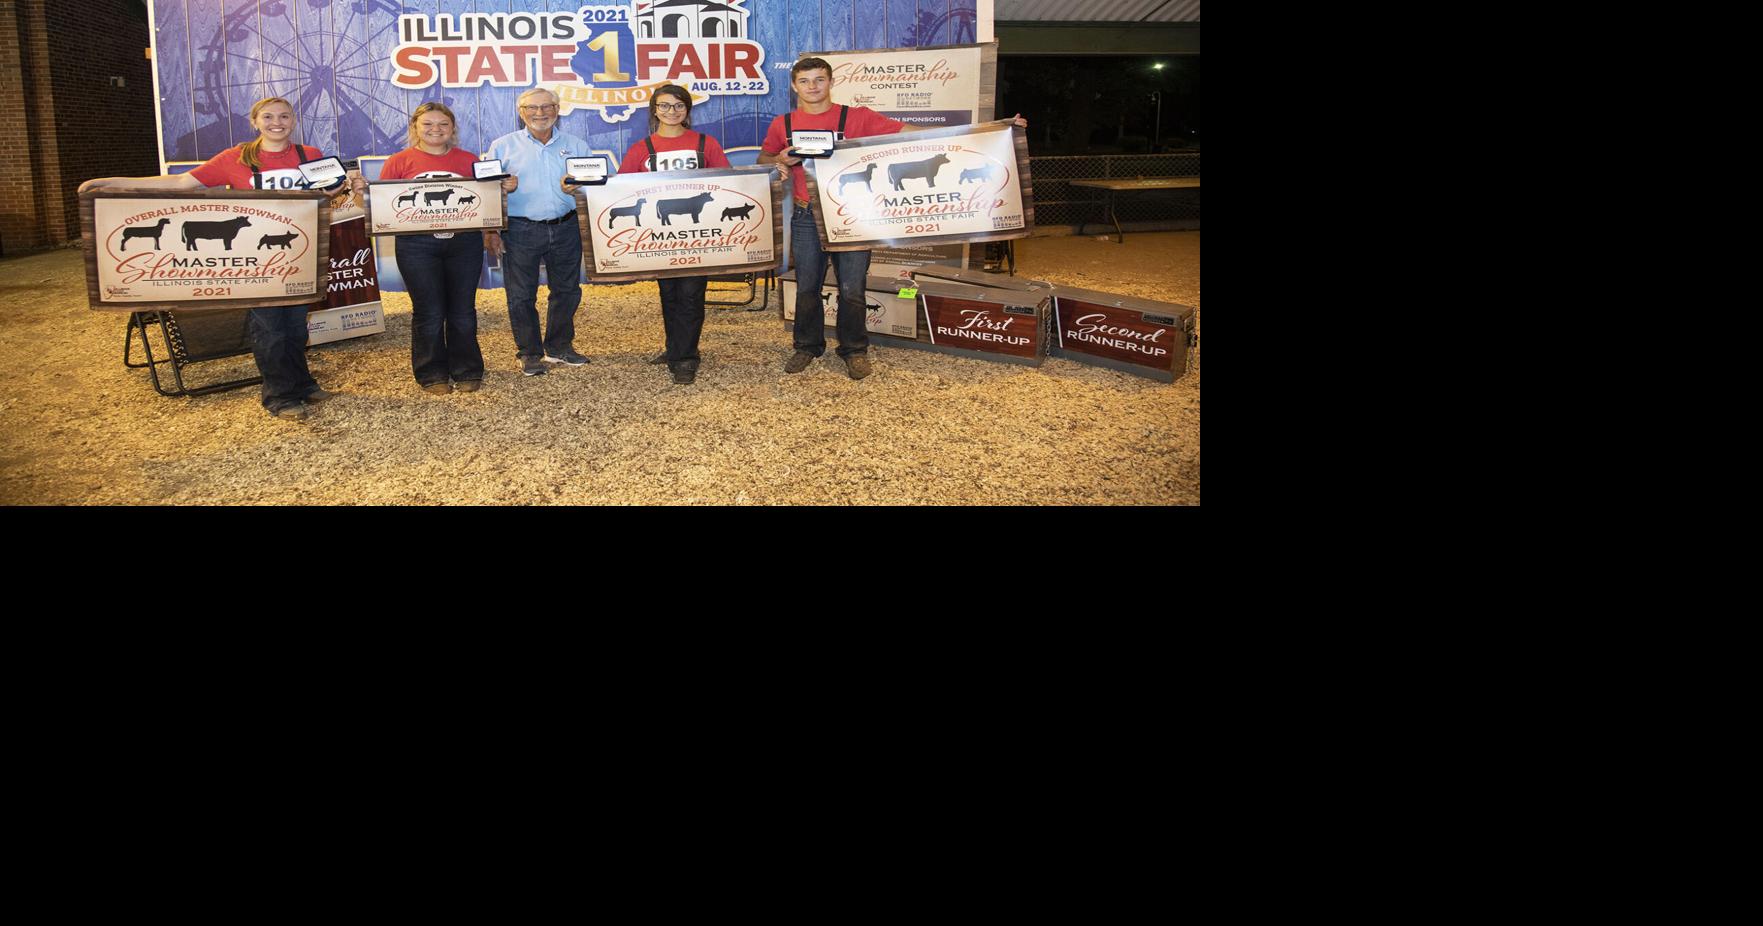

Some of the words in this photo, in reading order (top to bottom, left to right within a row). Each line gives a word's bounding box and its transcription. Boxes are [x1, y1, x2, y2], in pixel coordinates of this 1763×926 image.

[582, 9, 629, 22] 2021
[403, 15, 575, 42] ILLINOIS
[396, 44, 578, 85] STATE
[587, 31, 631, 82] 1
[637, 43, 761, 81] FAIR
[864, 63, 926, 74] MASTER
[691, 82, 723, 92] AUG.
[870, 82, 919, 90] CONTEST
[860, 148, 900, 163] SECOND
[901, 144, 945, 154] RUNNER
[659, 157, 698, 170] 105
[265, 176, 305, 190] 104
[635, 187, 663, 197] FIRST
[664, 183, 705, 192] RUNNER
[707, 184, 721, 192] UP
[884, 191, 962, 208] MASTER
[124, 207, 178, 226] OVERALL
[180, 204, 229, 214] MASTER
[232, 205, 293, 226] SHOWMAN
[420, 207, 459, 215] MASTER
[916, 214, 950, 222] STATE
[951, 212, 975, 220] FAIR
[651, 228, 723, 241] MASTER
[904, 223, 941, 234] 2021
[607, 221, 760, 257] Showmanship
[172, 257, 258, 267] MASTER
[328, 247, 371, 268] rall
[669, 256, 702, 265] 2021
[115, 251, 302, 284] Showmanship
[327, 268, 364, 281] STER
[192, 287, 232, 296] 2021
[326, 278, 375, 293] WMAN
[957, 309, 1015, 331] First
[1075, 313, 1166, 343] Second
[937, 326, 1031, 346] RUNNER-UP
[1066, 330, 1167, 356] RUNNER-UP
